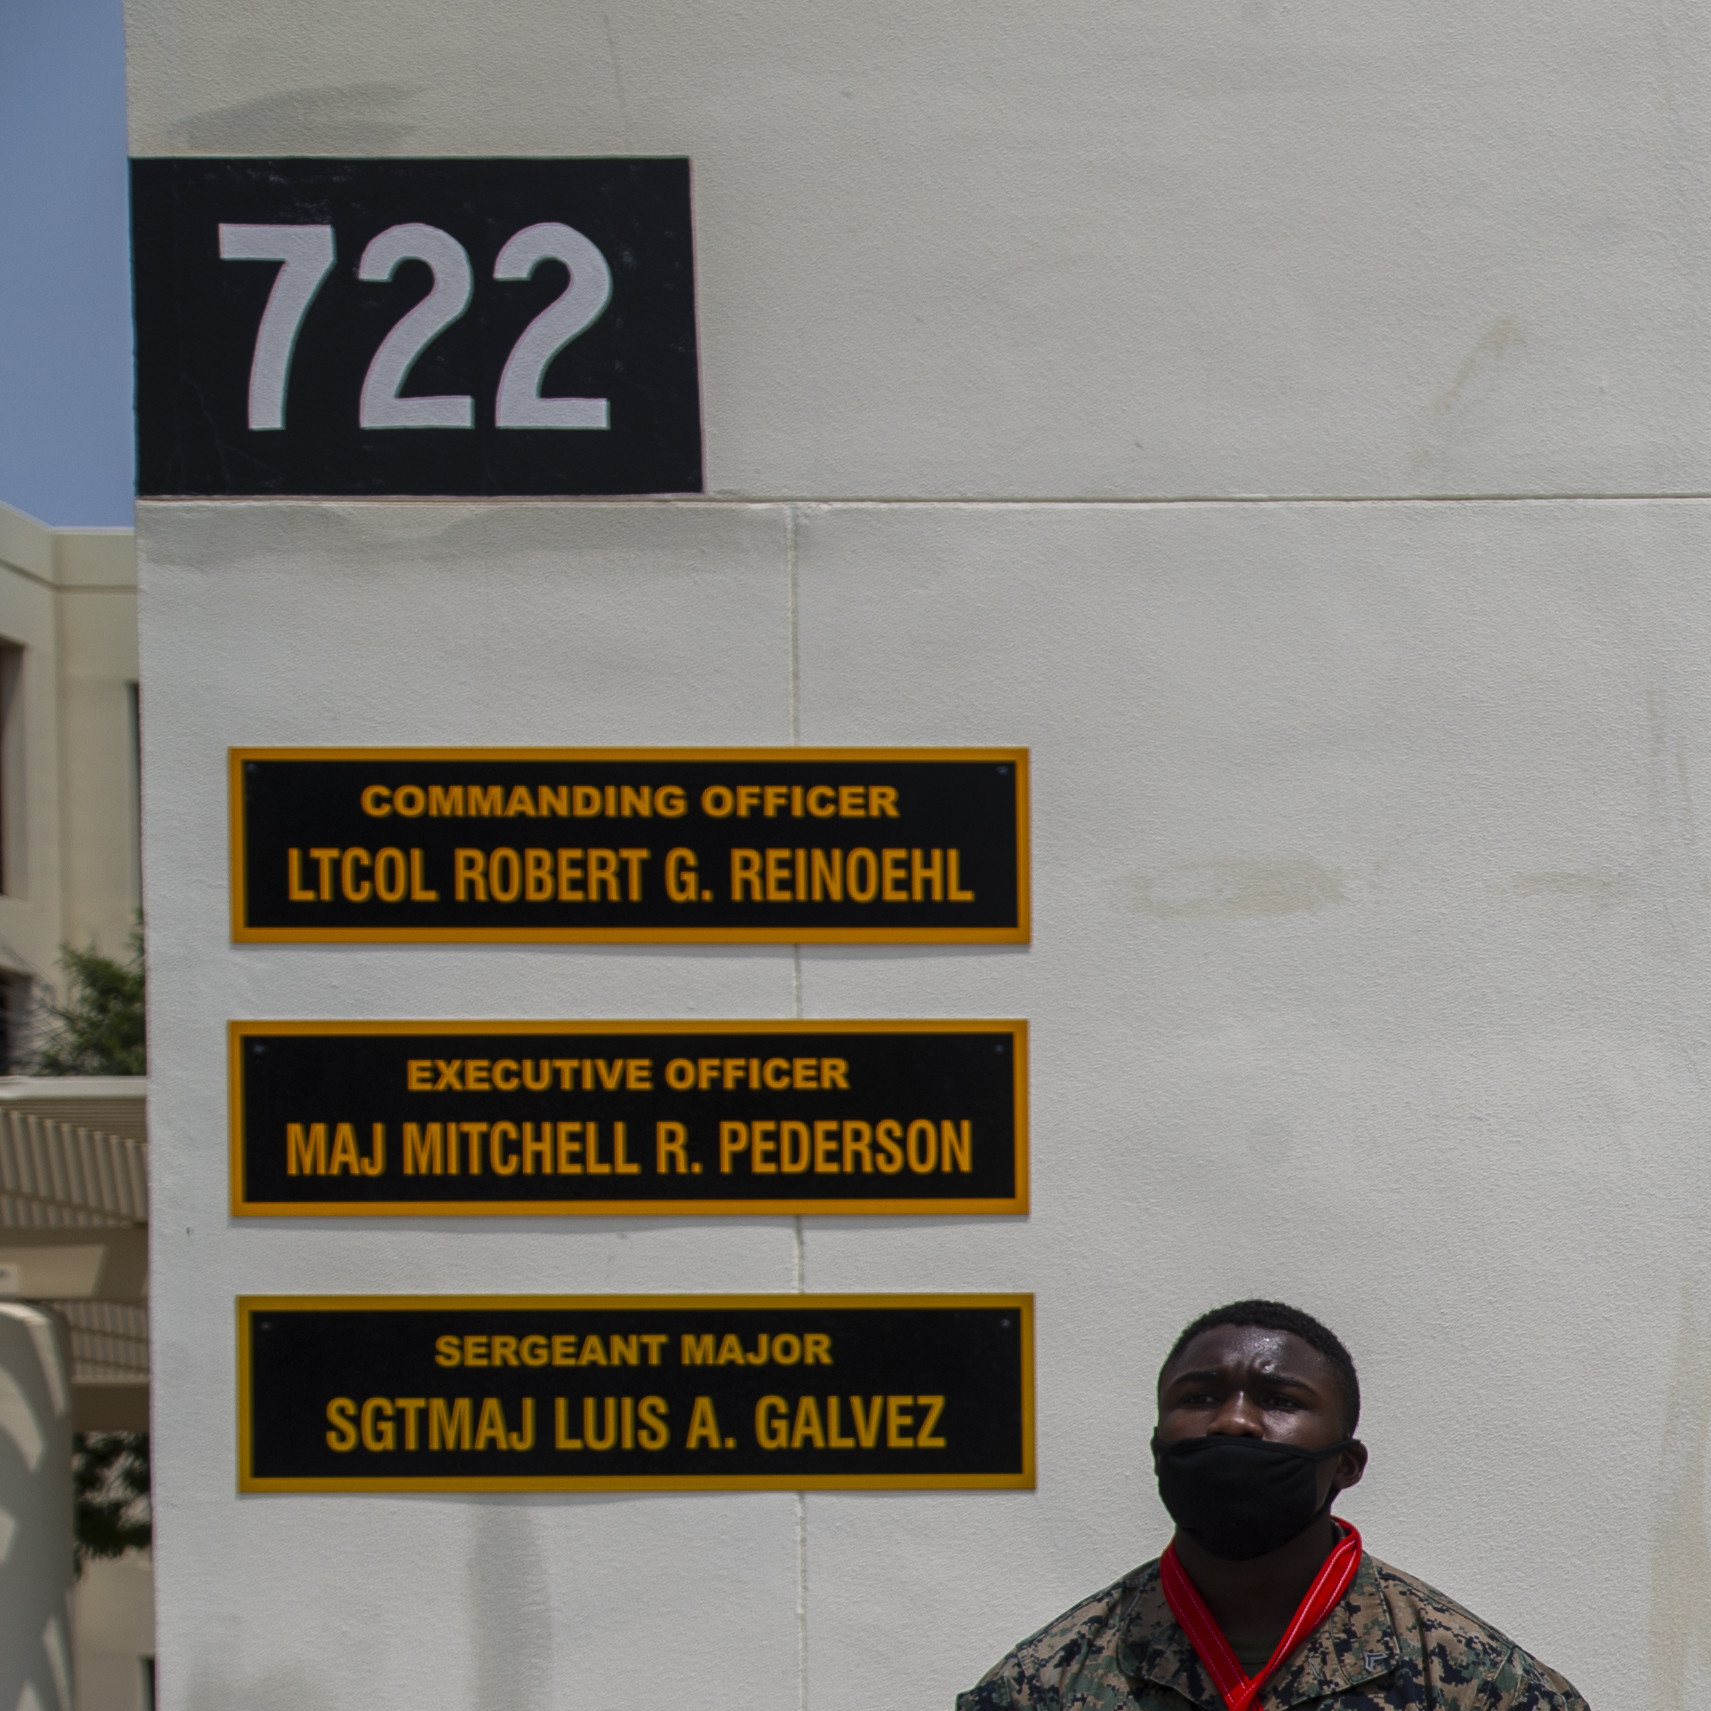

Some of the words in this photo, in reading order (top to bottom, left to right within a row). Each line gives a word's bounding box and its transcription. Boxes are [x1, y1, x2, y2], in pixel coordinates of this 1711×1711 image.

[218, 222, 612, 431] 722
[360, 784, 688, 818] COMMANDING
[701, 785, 900, 818] OFFICER
[288, 846, 438, 903] LTCOL
[454, 847, 650, 903] ROBERT
[664, 847, 713, 903] G.
[730, 847, 975, 903] REINOEHL
[406, 1057, 654, 1092] EXECUTIVE
[664, 1057, 850, 1091] OFFICER
[286, 1121, 385, 1177] MAJ
[402, 1120, 641, 1176] MITCHELL
[656, 1121, 703, 1175] R.
[719, 1118, 973, 1174] PEDERSON
[434, 1334, 669, 1368] SERGEANT
[681, 1333, 834, 1367] MAJOR
[326, 1396, 535, 1453] SGTMAJ
[554, 1395, 669, 1452] LUIS
[685, 1396, 737, 1450] A.
[754, 1394, 947, 1450] GALVEZ
